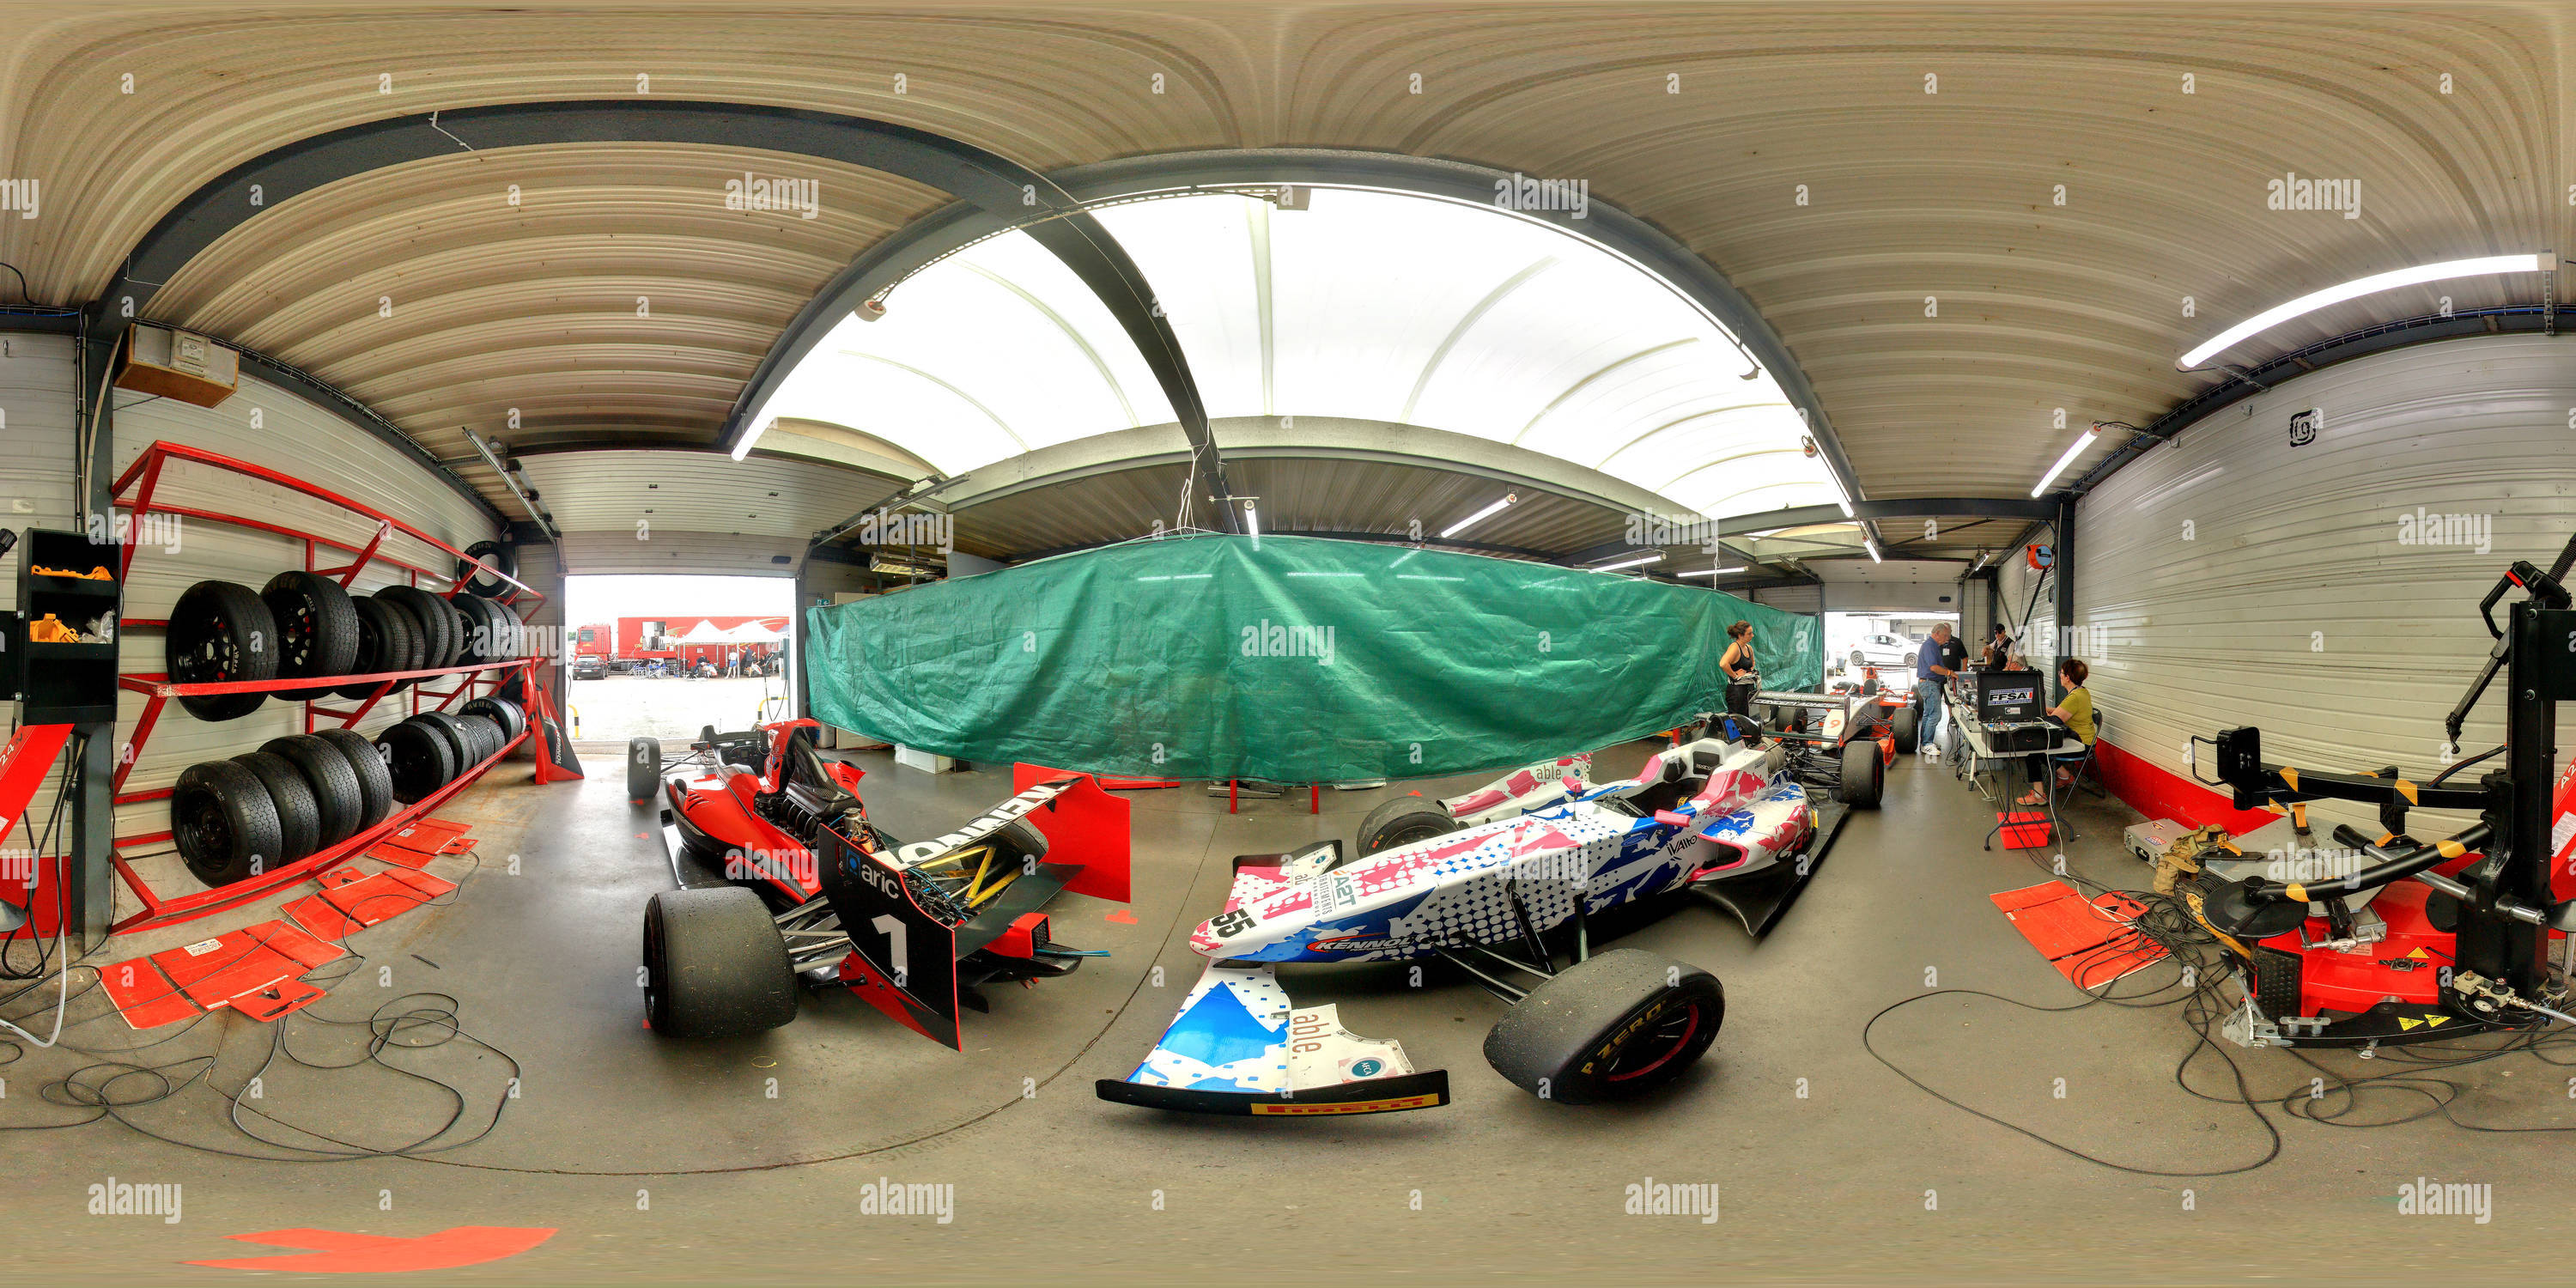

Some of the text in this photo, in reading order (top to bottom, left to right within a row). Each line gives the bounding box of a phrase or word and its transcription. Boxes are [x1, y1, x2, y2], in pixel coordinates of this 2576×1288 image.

[1990, 692, 2027, 702] FFSA
[1536, 765, 1561, 780] able
[861, 864, 900, 900] aric
[1334, 876, 1357, 906] A2T
[1211, 908, 1257, 939] 55
[872, 914, 908, 976] 1
[1315, 936, 1413, 951] KENNOL
[1292, 1014, 1332, 1060] able.
[1581, 1003, 1662, 1074] P ZERO
[1361, 1061, 1372, 1076] AFCA
